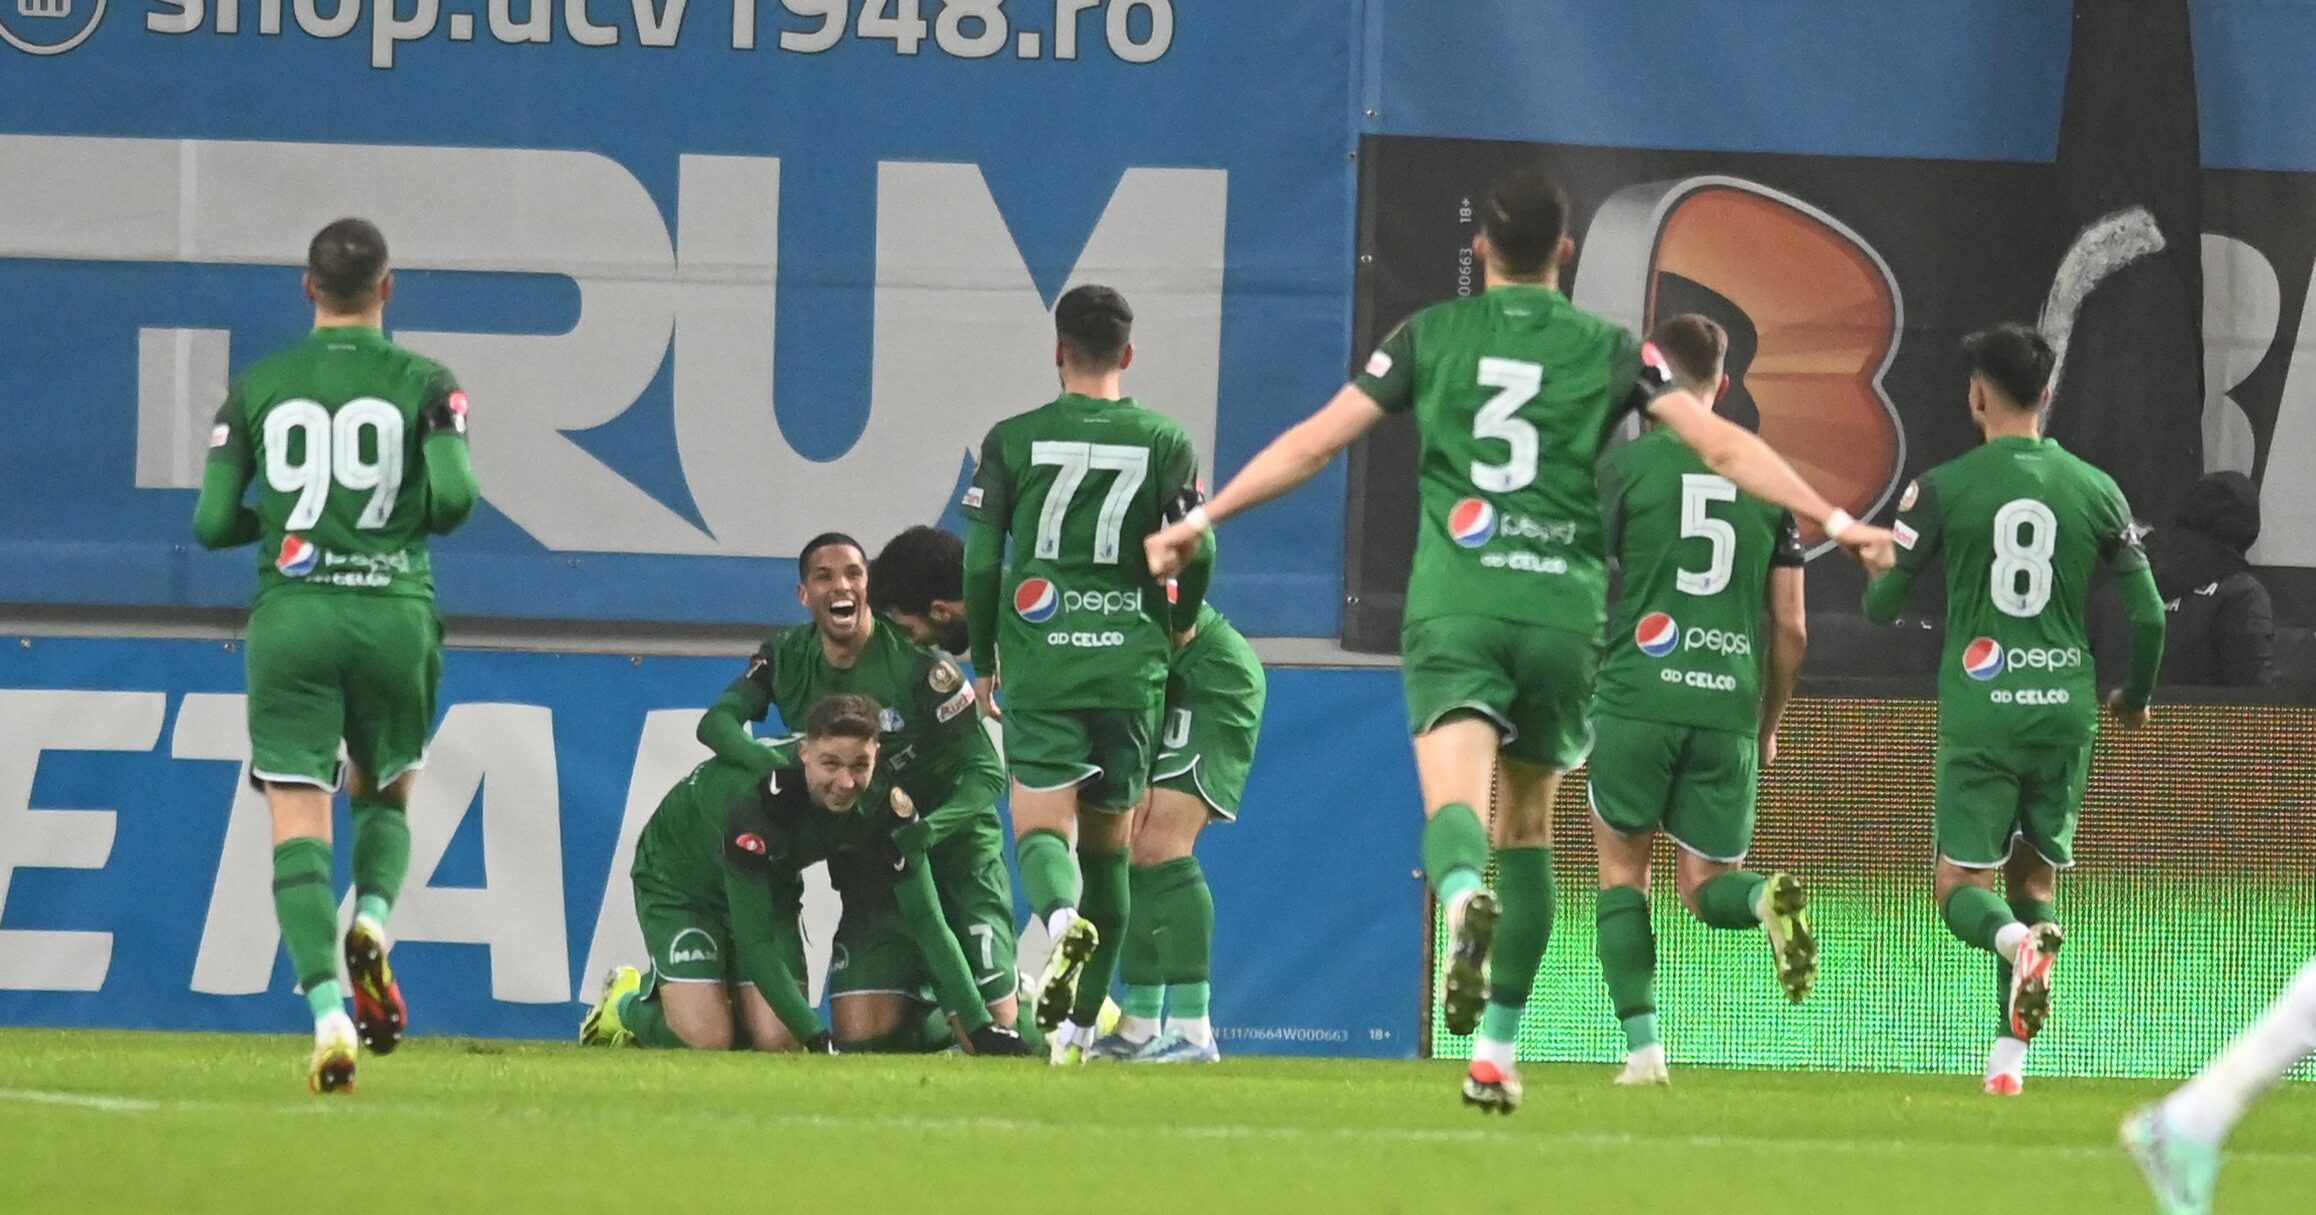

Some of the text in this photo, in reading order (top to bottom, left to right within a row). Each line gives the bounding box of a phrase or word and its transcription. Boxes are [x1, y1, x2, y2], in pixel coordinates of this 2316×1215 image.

[1459, 198, 1472, 223] 18+
[1471, 356, 1543, 492] 3
[264, 397, 404, 531] 99
[1031, 440, 1150, 564] 77
[1676, 473, 1737, 596] 5
[1991, 498, 2057, 618] 8
[1063, 587, 1142, 615] pepsi
[1071, 631, 1125, 647] CELCO
[1684, 626, 1750, 656] pepsi
[2007, 647, 2081, 672] pepsi
[1685, 671, 1736, 691] CELCO
[2015, 688, 2069, 704] CELCO
[969, 924, 995, 970] 7
[1368, 1028, 1391, 1041] 18+
